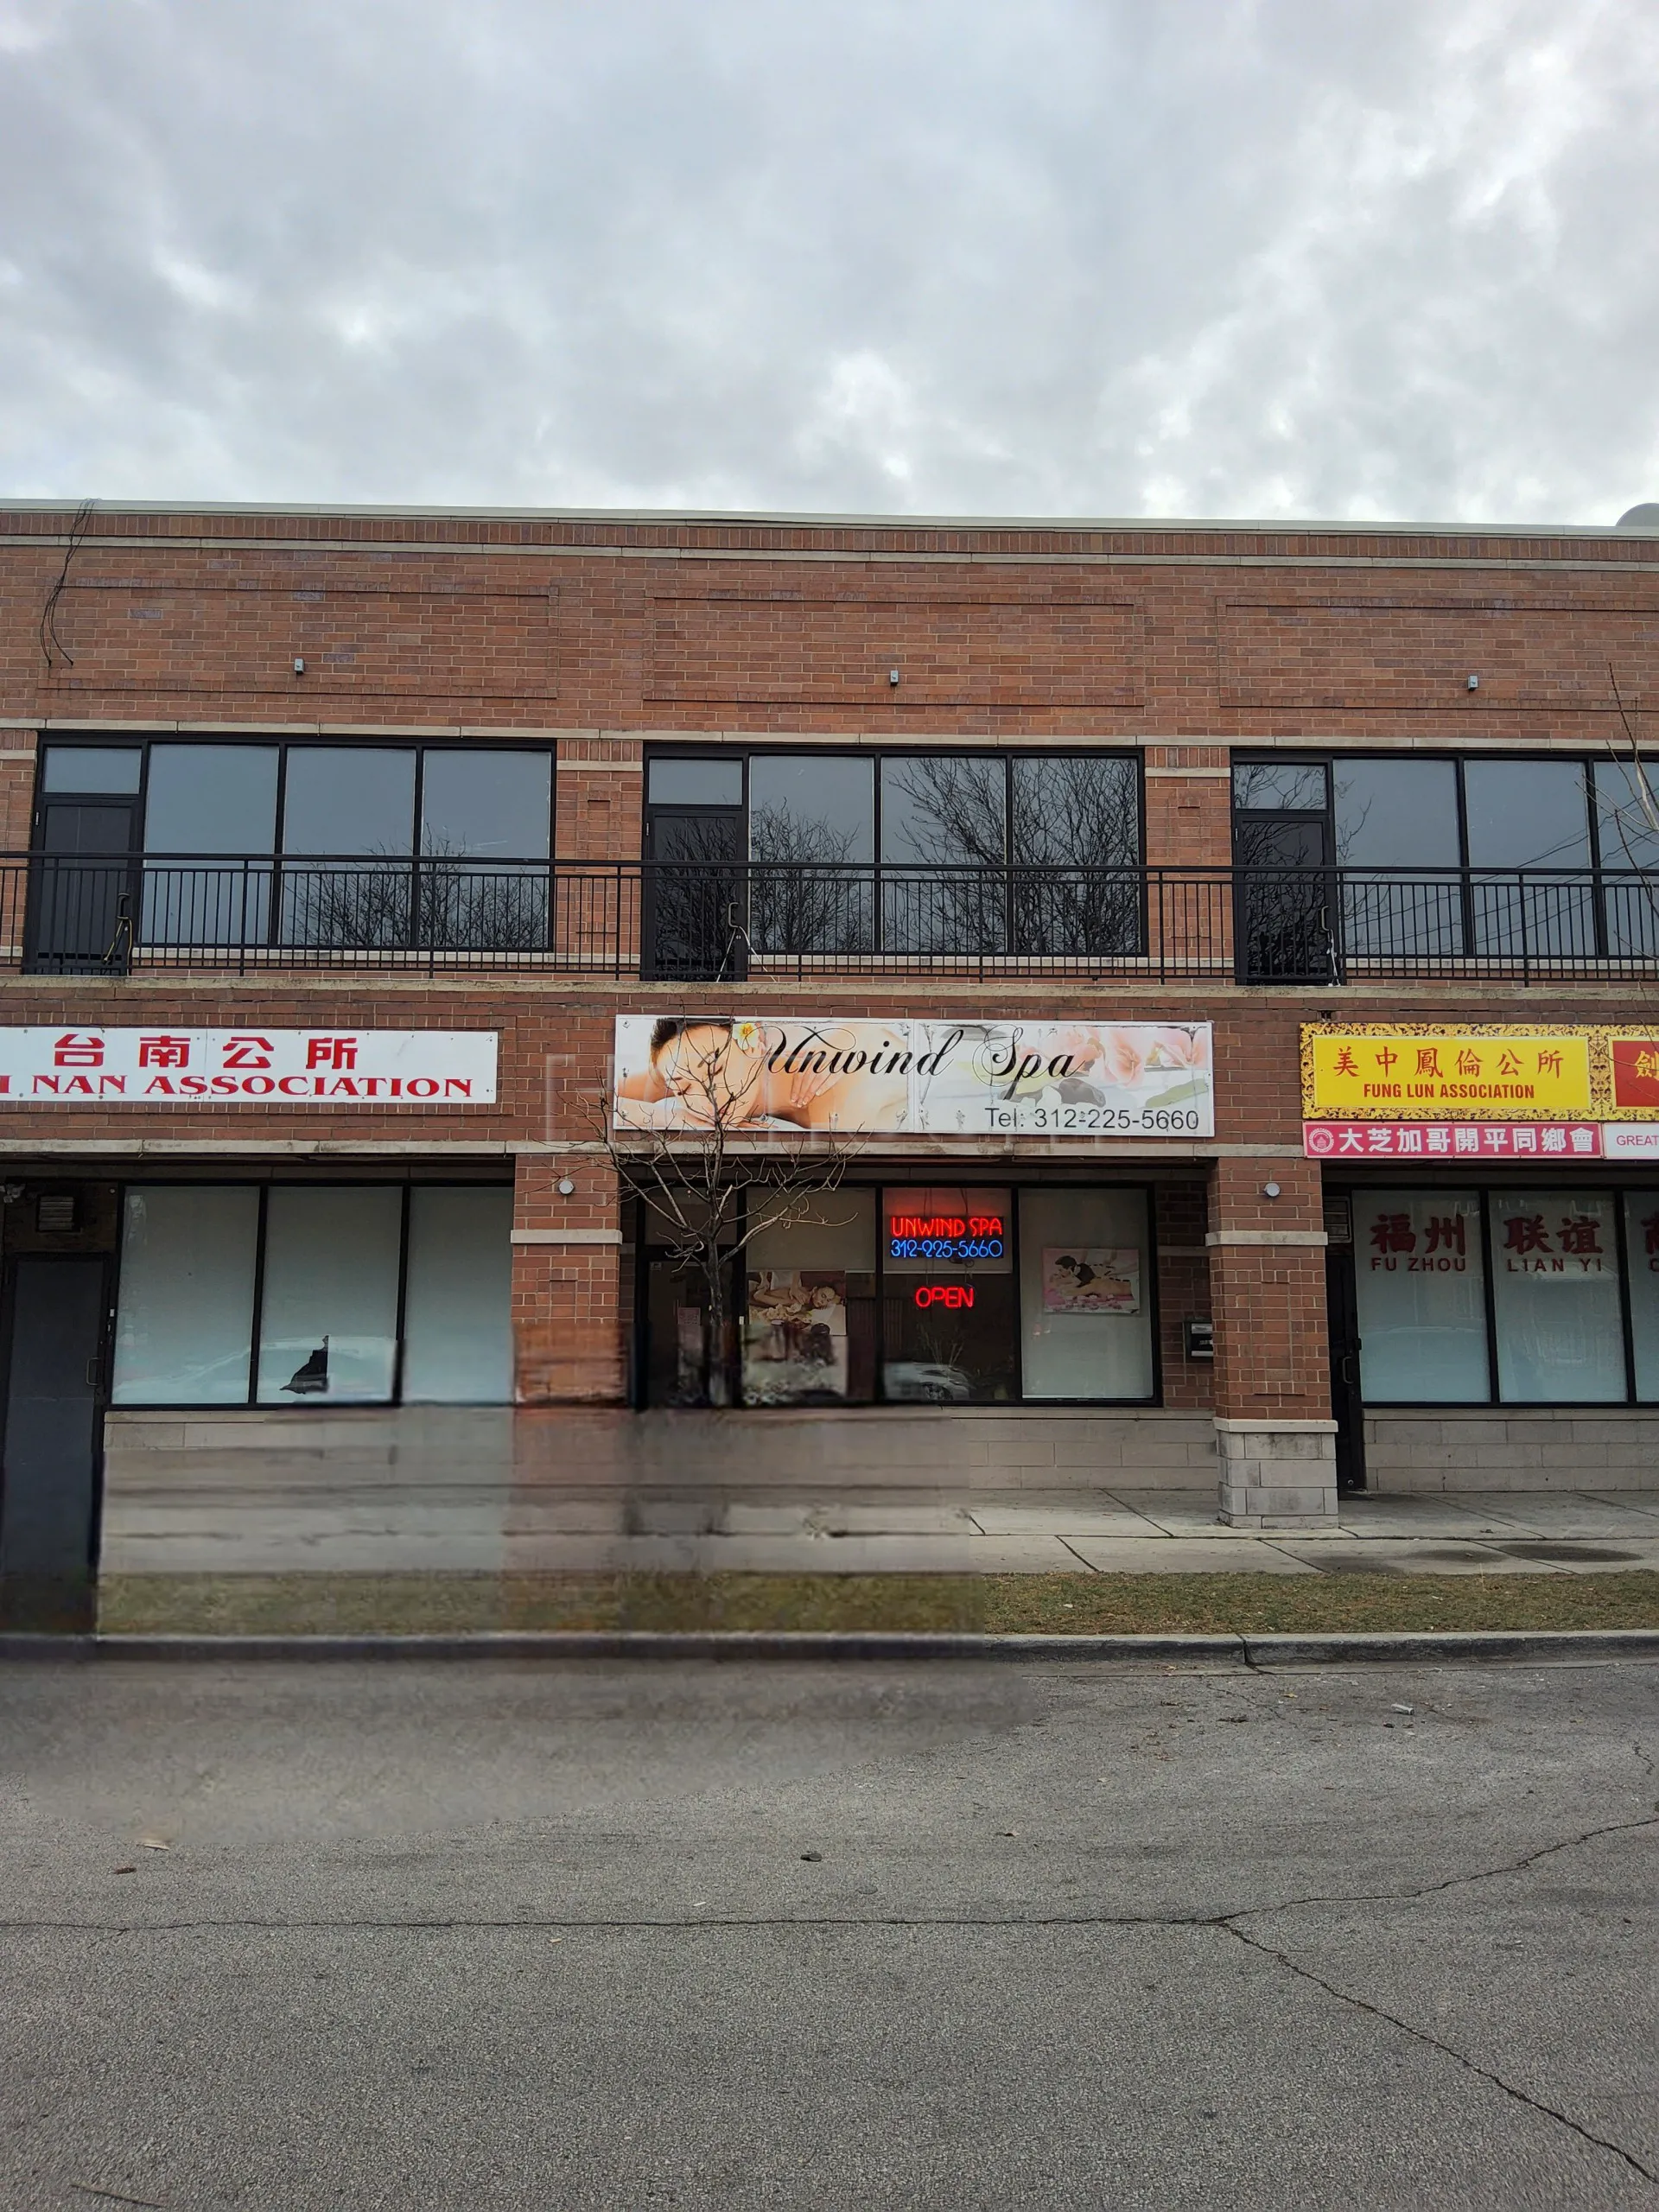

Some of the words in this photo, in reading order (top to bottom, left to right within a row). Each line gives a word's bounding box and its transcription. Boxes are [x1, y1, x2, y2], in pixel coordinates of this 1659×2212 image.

[54, 1033, 358, 1070] 台南公所
[742, 1025, 955, 1076] Unwind
[972, 1023, 1085, 1101] Spa
[1333, 1045, 1564, 1079] 美中鳳倫公所
[32, 1075, 128, 1095] NAN
[143, 1076, 473, 1097] ASSOCIATION
[1363, 1084, 1402, 1098] FUNG
[1407, 1084, 1434, 1098] LUN
[1440, 1084, 1535, 1099] ASSOCIATION
[984, 1107, 1024, 1128] Tel:
[1034, 1108, 1199, 1130] 312-225-5660
[1338, 1127, 1594, 1153] 大芝加哥開平同鄉會
[1617, 1135, 1659, 1147] GREAT
[891, 1217, 965, 1238] UNWIND
[969, 1217, 1003, 1237] SPA
[1370, 1213, 1466, 1256] 福州
[1503, 1214, 1604, 1255] 联谊
[890, 1239, 1003, 1259] 312-225-5660
[1371, 1257, 1397, 1272] FU
[1408, 1257, 1466, 1272] ZHOU
[1507, 1258, 1565, 1273] LIAN
[1582, 1258, 1602, 1273] YI
[915, 1286, 974, 1308] OPEN
